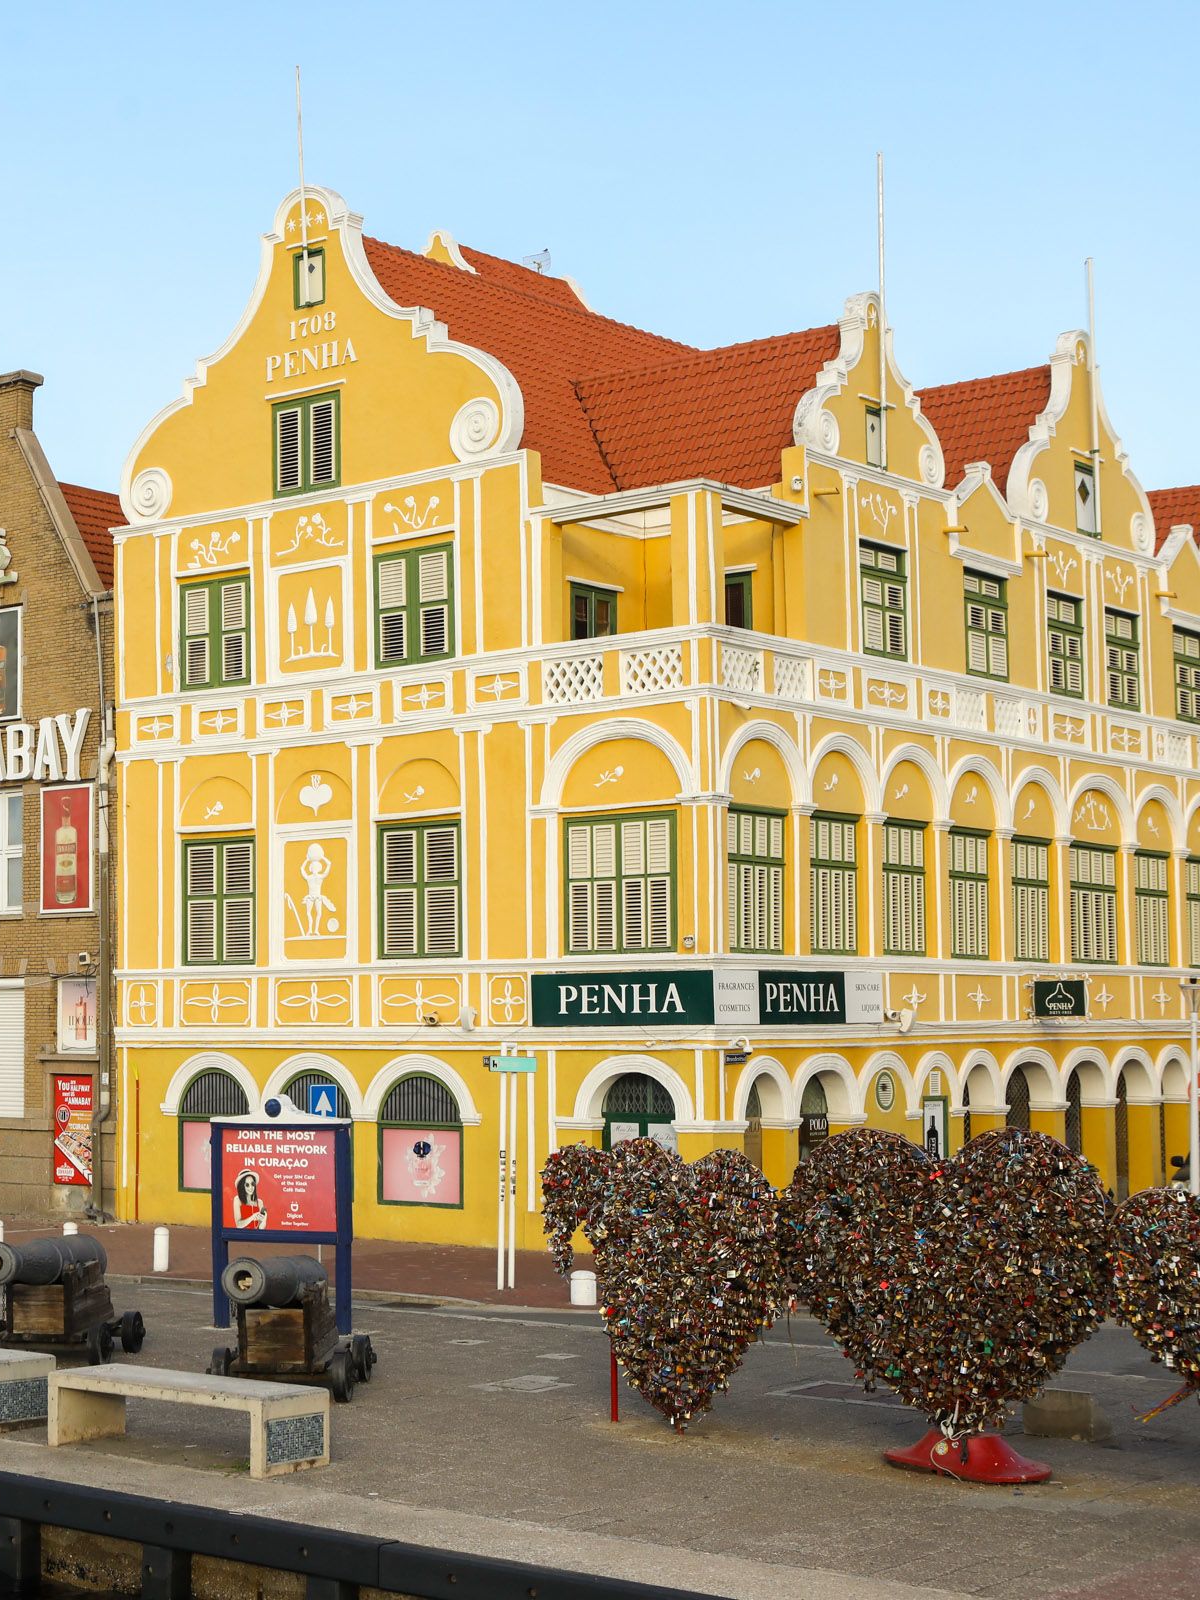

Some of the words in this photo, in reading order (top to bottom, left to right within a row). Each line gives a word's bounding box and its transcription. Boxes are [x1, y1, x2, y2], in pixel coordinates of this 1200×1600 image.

[289, 311, 336, 341] 1708
[266, 337, 359, 383] PENHA
[718, 982, 755, 991] FRAGRANCES
[855, 983, 866, 992] SKIN
[867, 983, 880, 992] CARE
[558, 982, 686, 1015] PENHA
[765, 983, 840, 1013] PENHA
[719, 1003, 751, 1012] COSMETICS
[861, 1004, 881, 1013] LIQUOR
[1049, 1002, 1072, 1011] PENHA
[68, 1097, 91, 1105] ANNABAY
[809, 1118, 827, 1131] POLO
[237, 1130, 260, 1140] JOIN
[263, 1131, 283, 1140] THE
[286, 1131, 315, 1140] MOST
[226, 1144, 272, 1153] RELIABLE
[276, 1145, 327, 1154] NETWORK
[244, 1157, 255, 1166] IN
[258, 1158, 308, 1169] CURAÇAO
